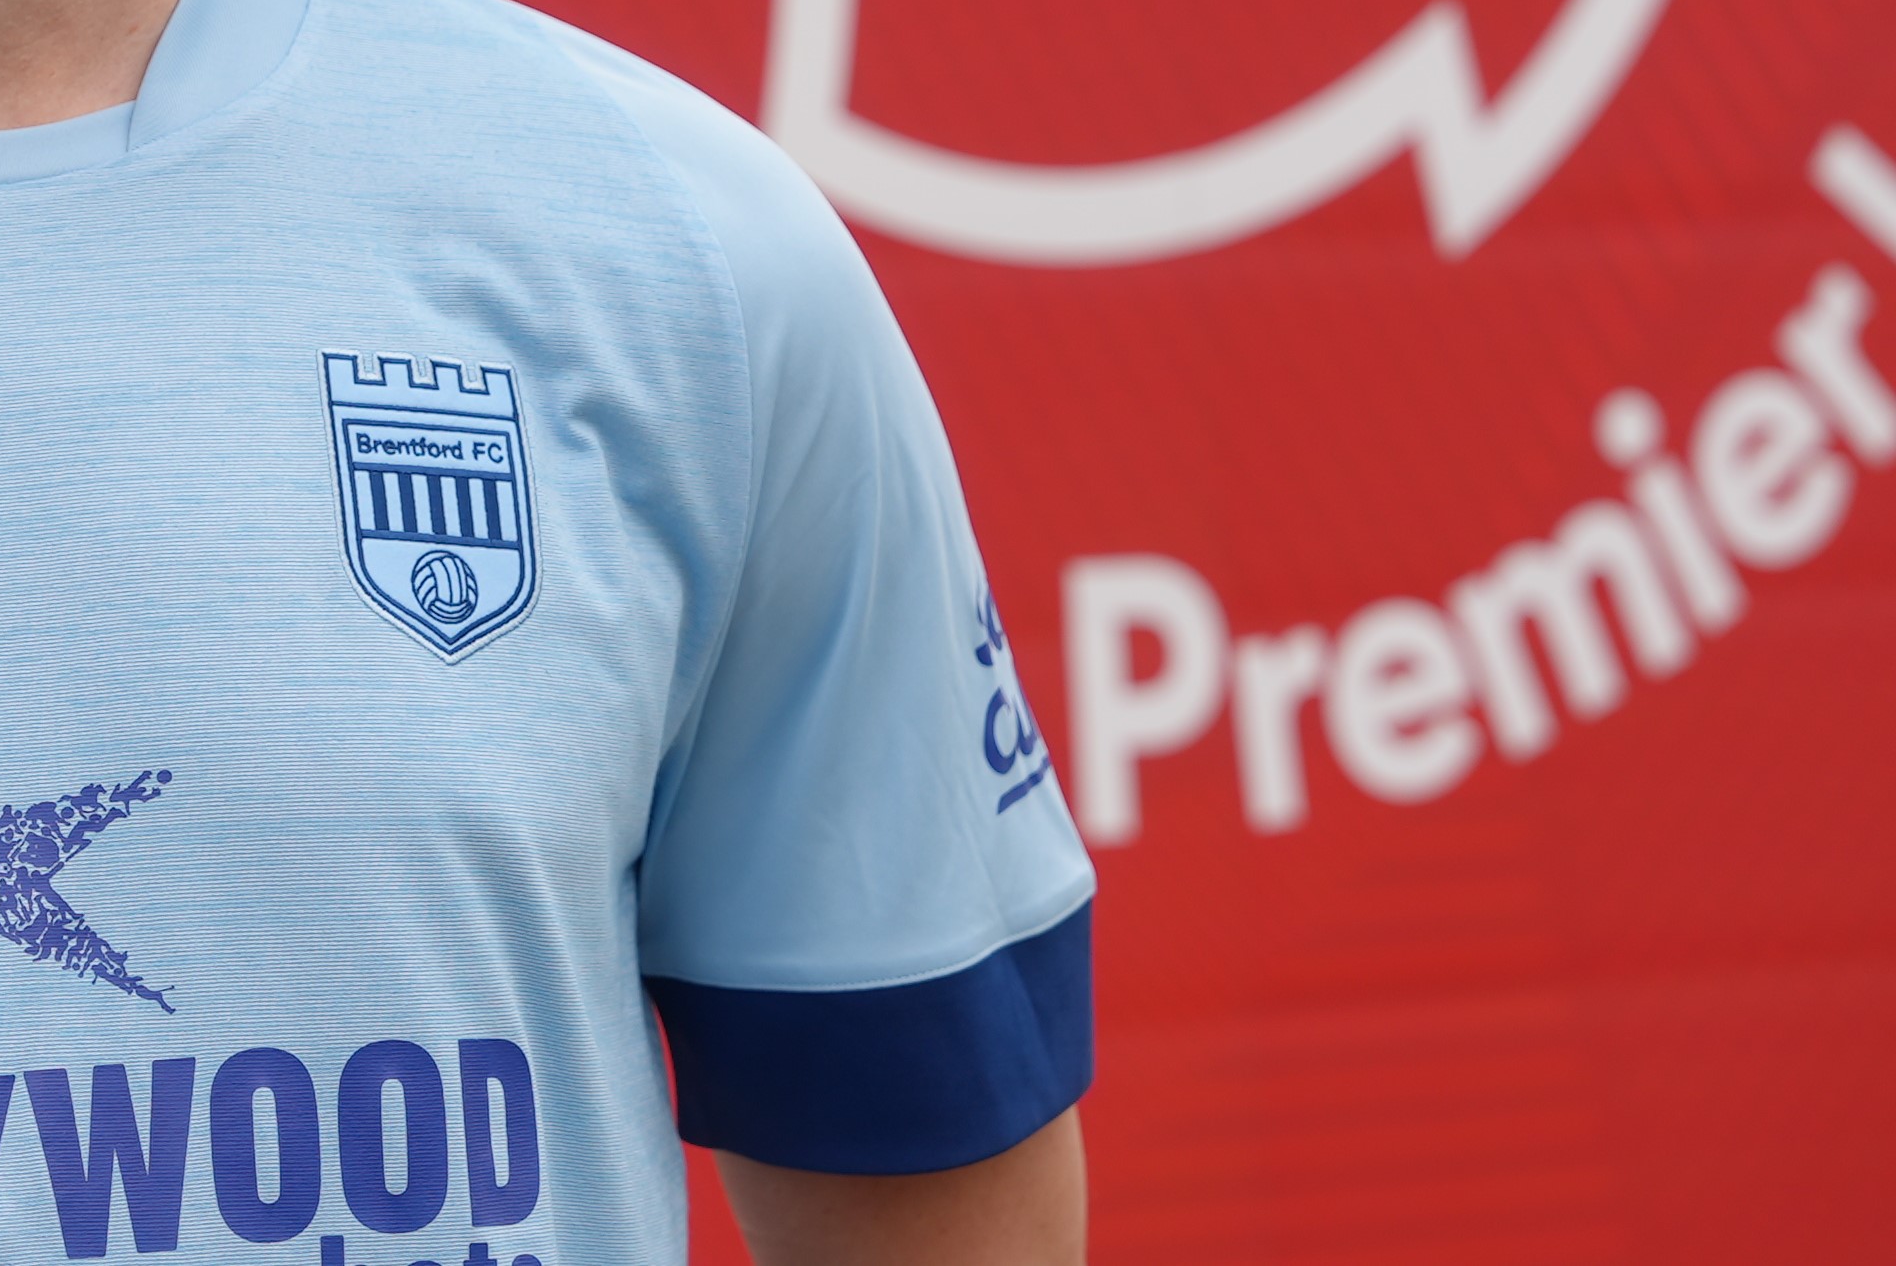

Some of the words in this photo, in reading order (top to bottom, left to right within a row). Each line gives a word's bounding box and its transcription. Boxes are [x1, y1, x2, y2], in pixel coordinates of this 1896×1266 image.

[356, 432, 464, 460] Brentford
[472, 441, 504, 464] FC
[1062, 260, 1896, 847] Premier
